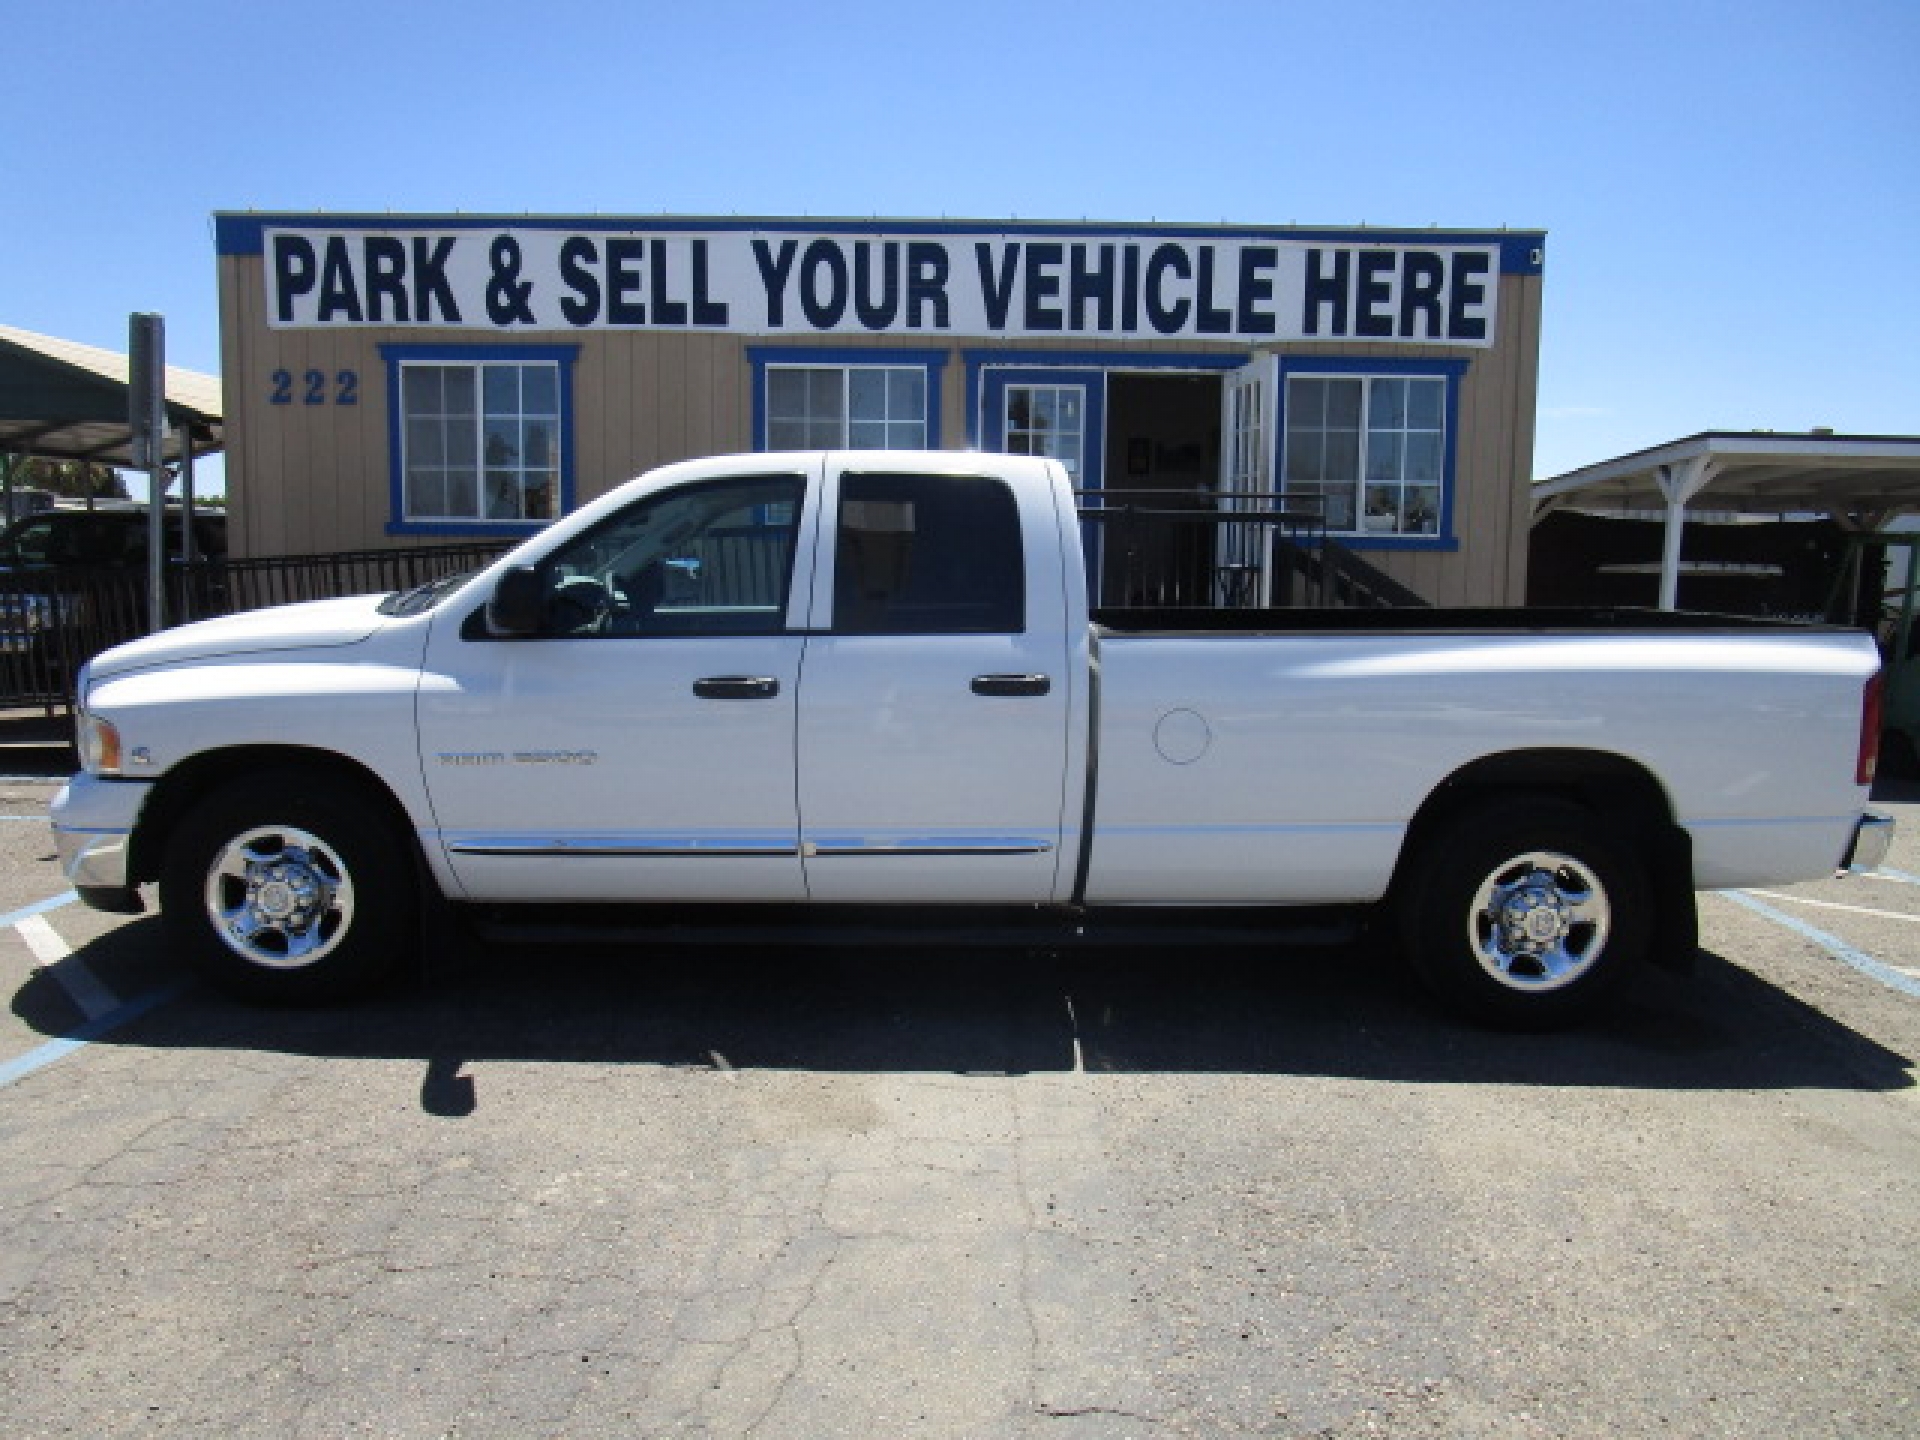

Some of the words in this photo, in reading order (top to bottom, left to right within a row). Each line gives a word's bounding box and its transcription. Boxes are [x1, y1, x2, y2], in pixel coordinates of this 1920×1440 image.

[273, 236, 462, 323] PARK
[485, 234, 537, 326] &
[558, 236, 729, 327] SELL
[750, 237, 951, 330] YOUR
[975, 242, 1279, 334] VEHICLE
[1302, 248, 1492, 340] HERE
[270, 369, 359, 405] 222
